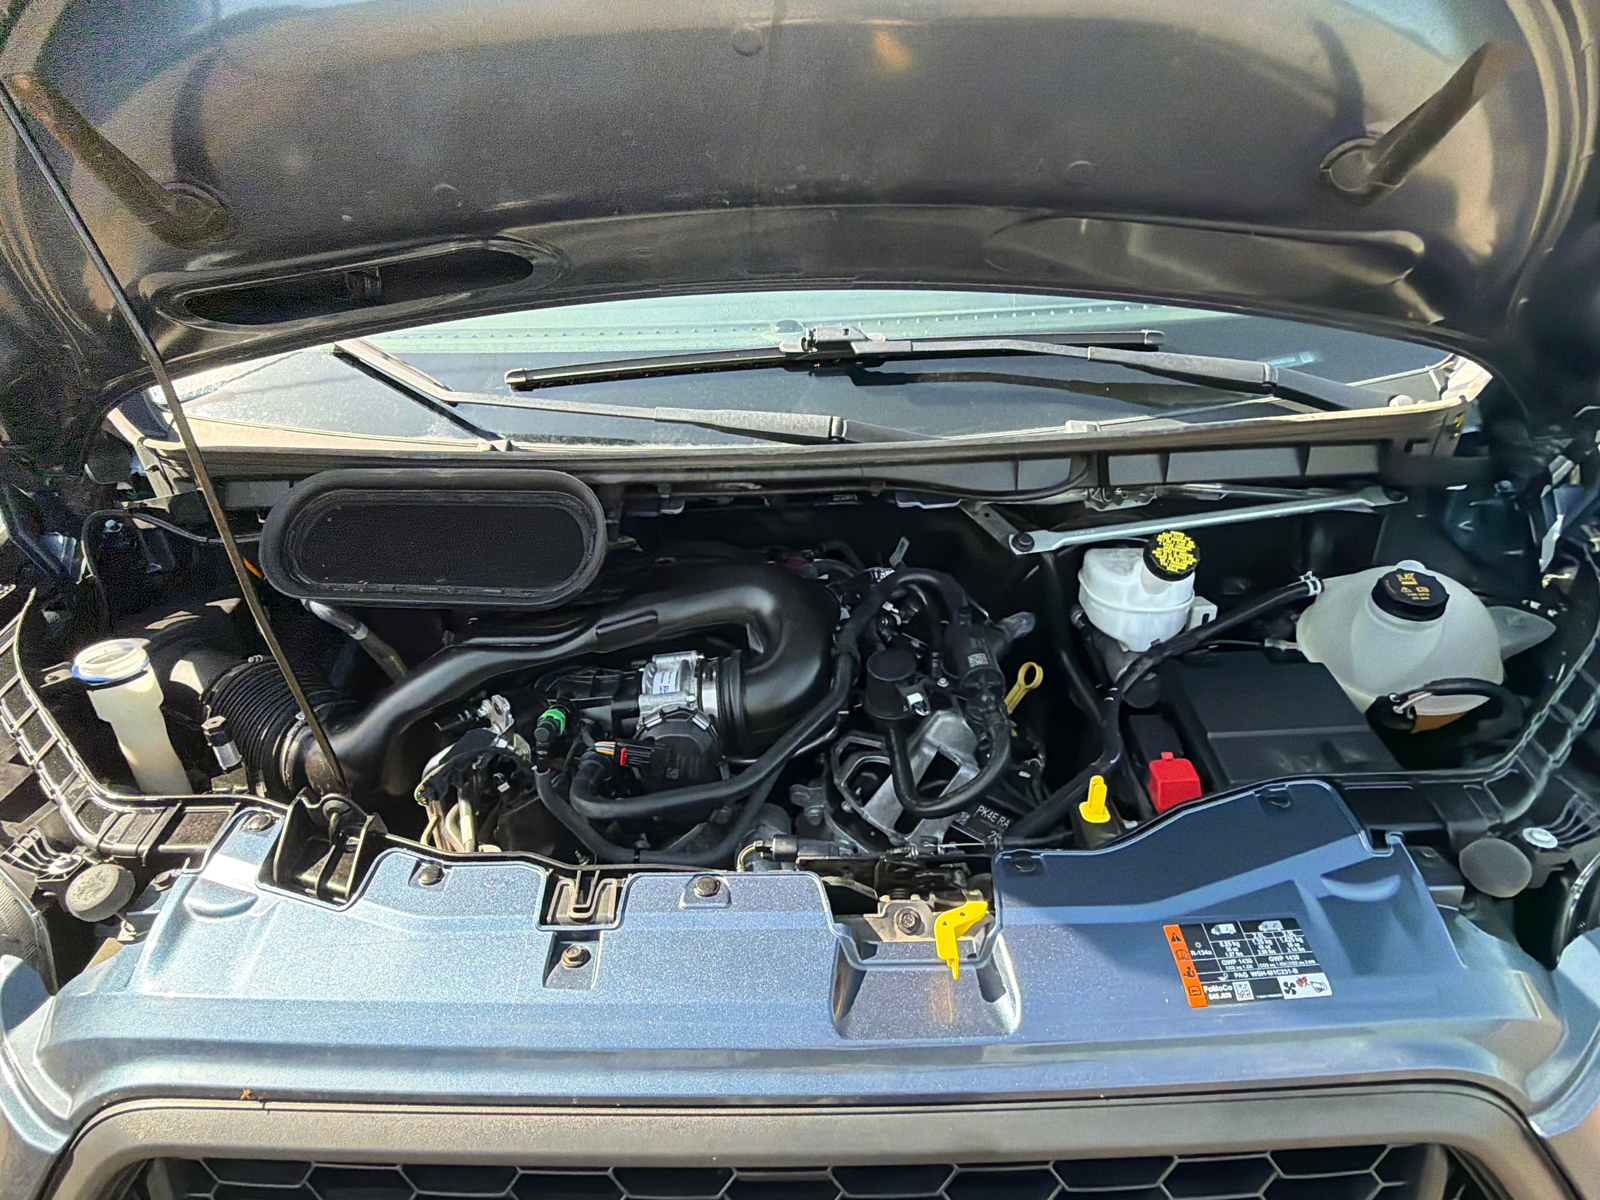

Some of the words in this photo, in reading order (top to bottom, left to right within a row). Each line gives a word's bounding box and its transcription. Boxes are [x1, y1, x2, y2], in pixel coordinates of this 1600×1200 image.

[974, 805, 999, 823] PK4E
[998, 816, 1011, 828] RA
[1190, 949, 1213, 957] R-134a
[1234, 971, 1249, 979] PAG
[1203, 984, 1233, 993] FoMoCo
